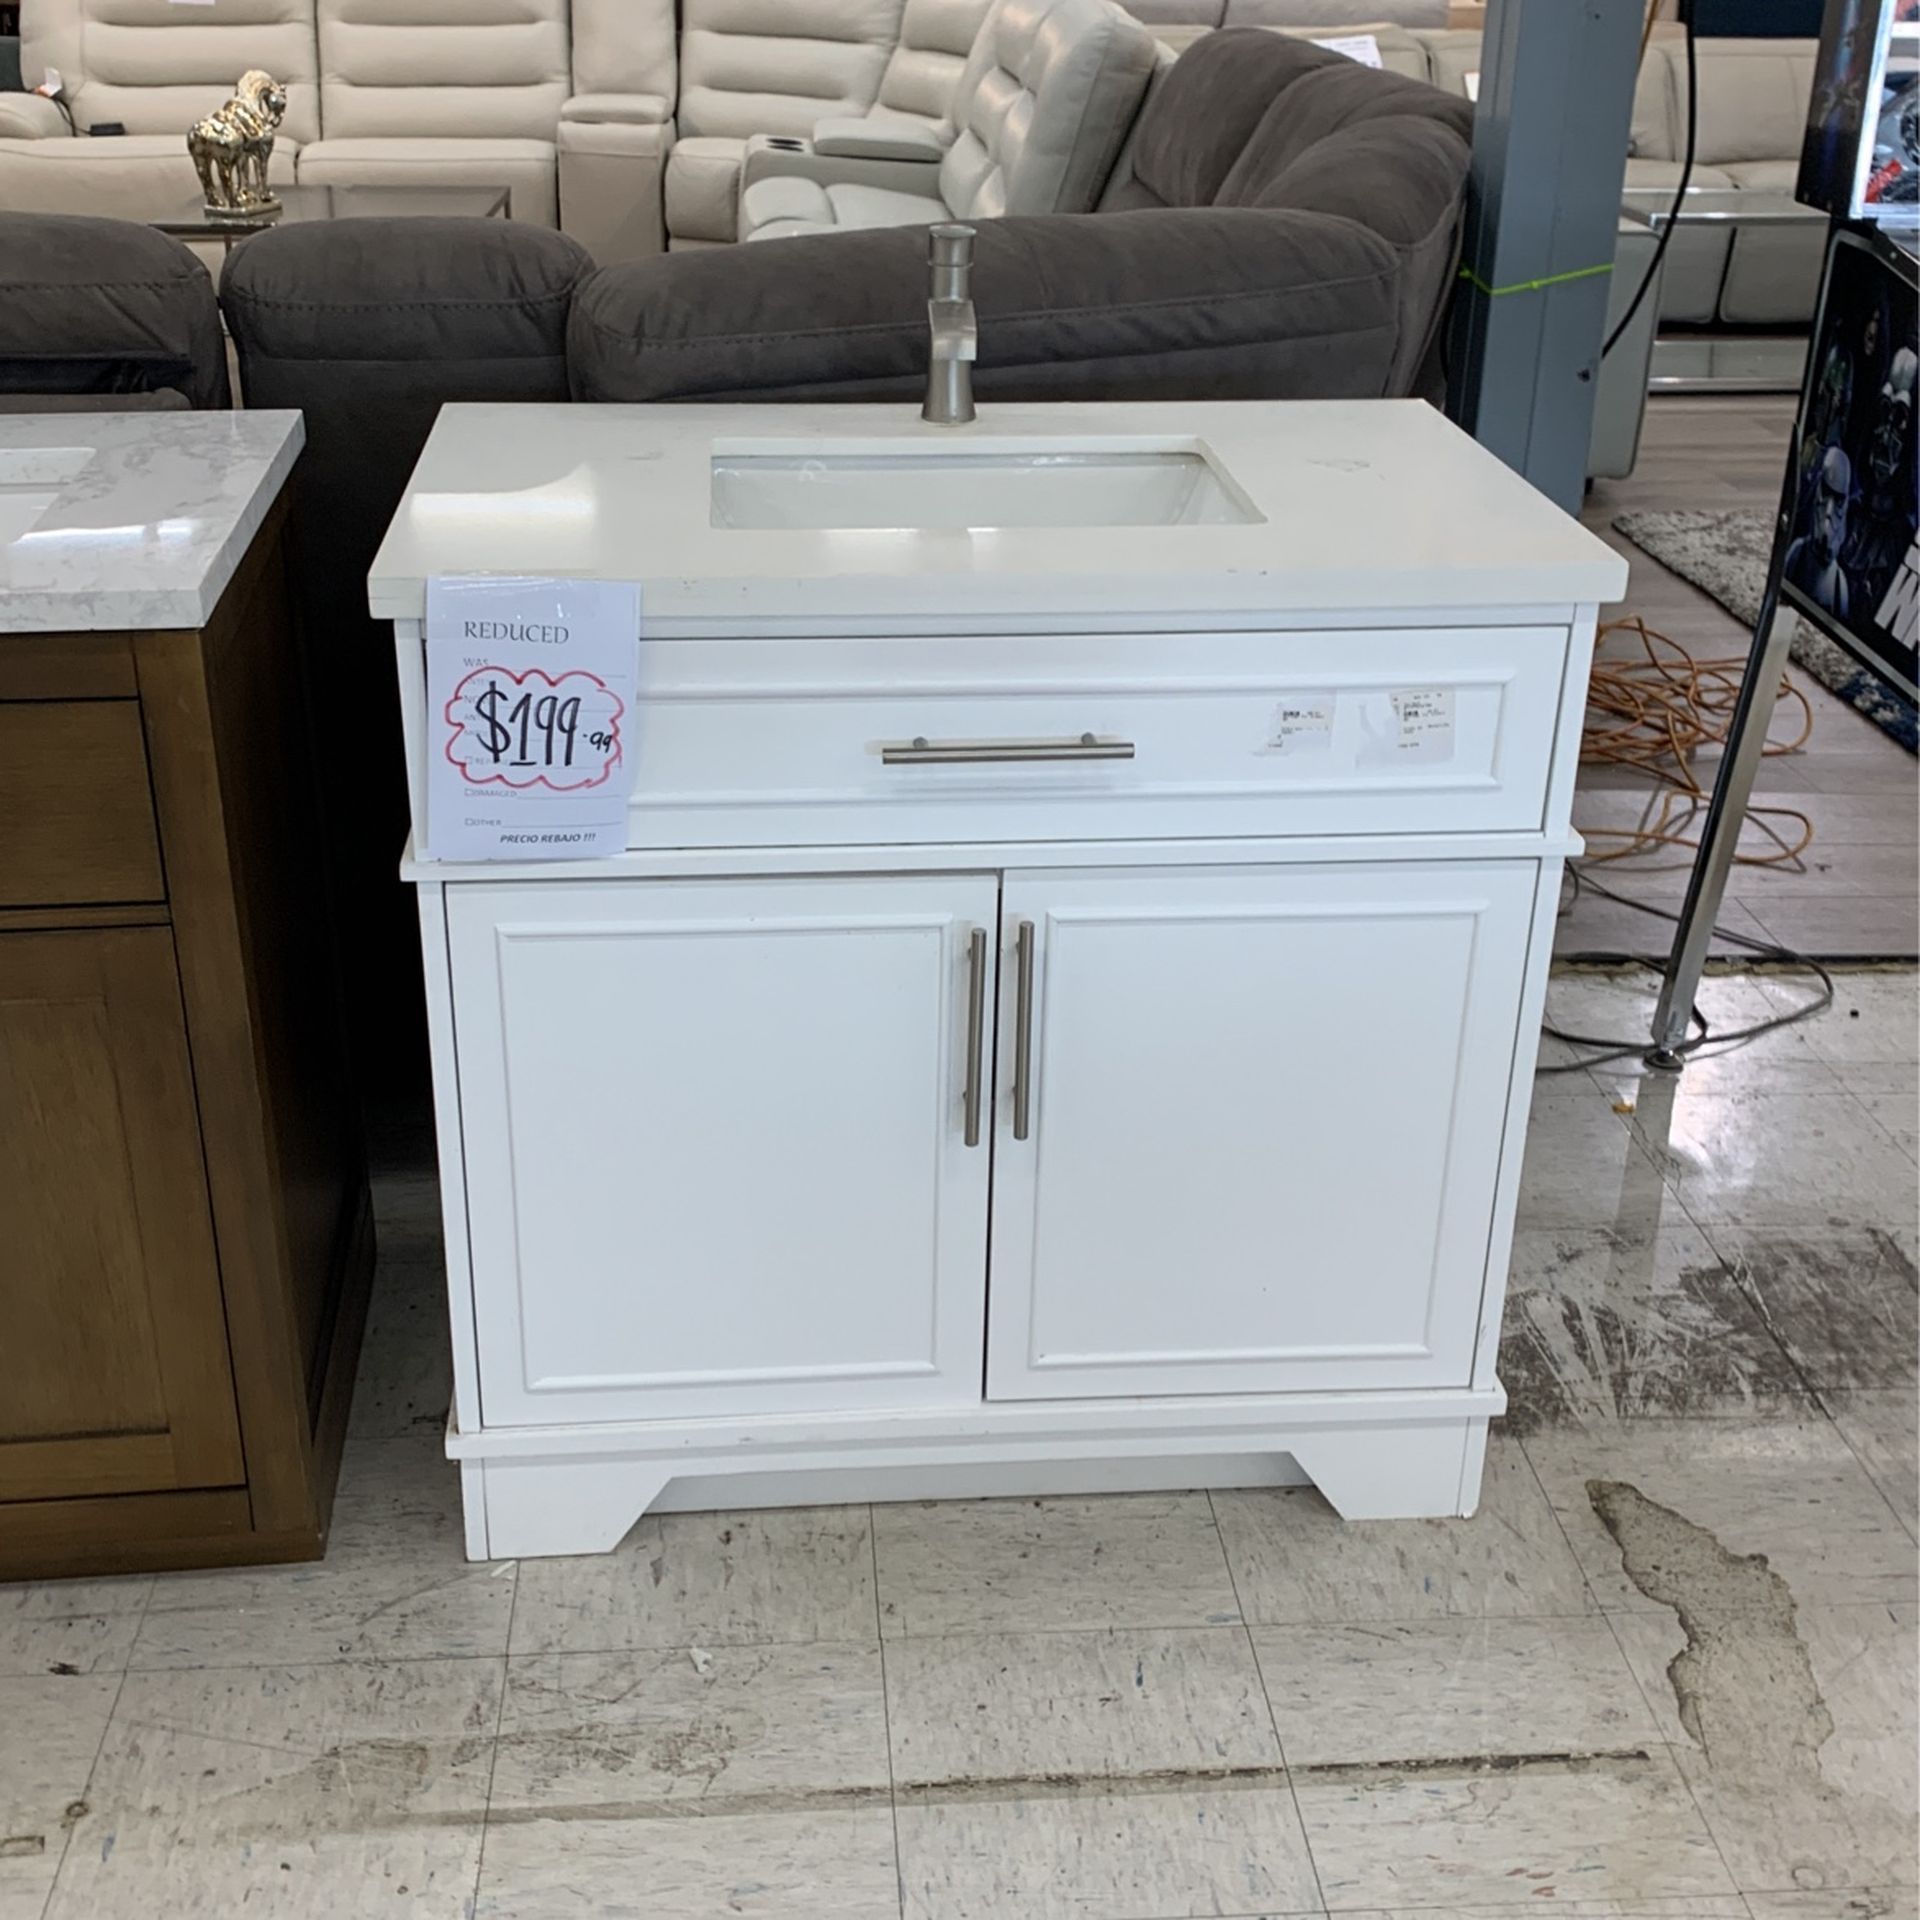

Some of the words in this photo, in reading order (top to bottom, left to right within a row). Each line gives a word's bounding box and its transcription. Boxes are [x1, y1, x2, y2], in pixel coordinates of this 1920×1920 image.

[464, 621, 570, 644] REDUCED
[463, 658, 489, 668] WAS
[475, 818, 502, 827] OTHER
[500, 834, 539, 844] PRECIO
[541, 832, 582, 844] REBAJO
